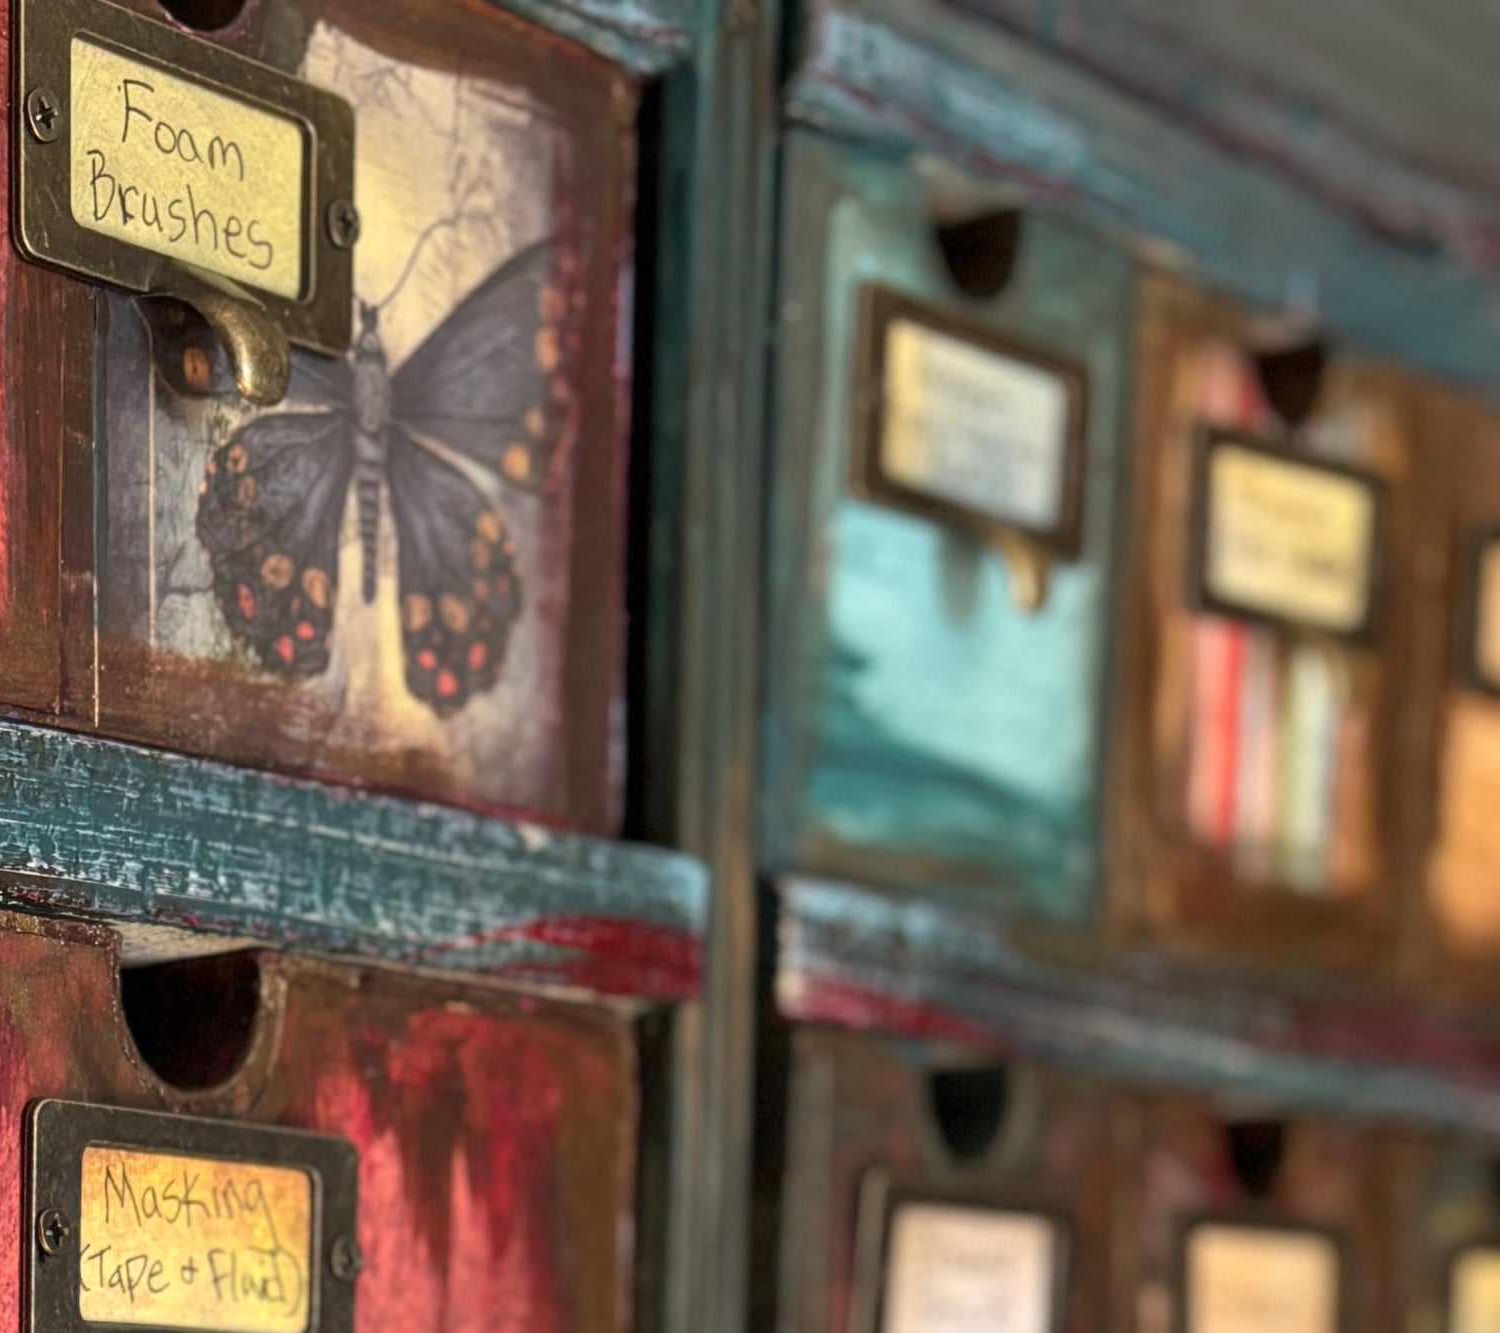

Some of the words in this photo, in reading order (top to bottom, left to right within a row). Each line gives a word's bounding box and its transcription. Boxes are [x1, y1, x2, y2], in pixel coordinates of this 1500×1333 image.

[117, 78, 244, 182] Foam
[86, 149, 274, 270] Brushes
[102, 1160, 280, 1250] Masking
